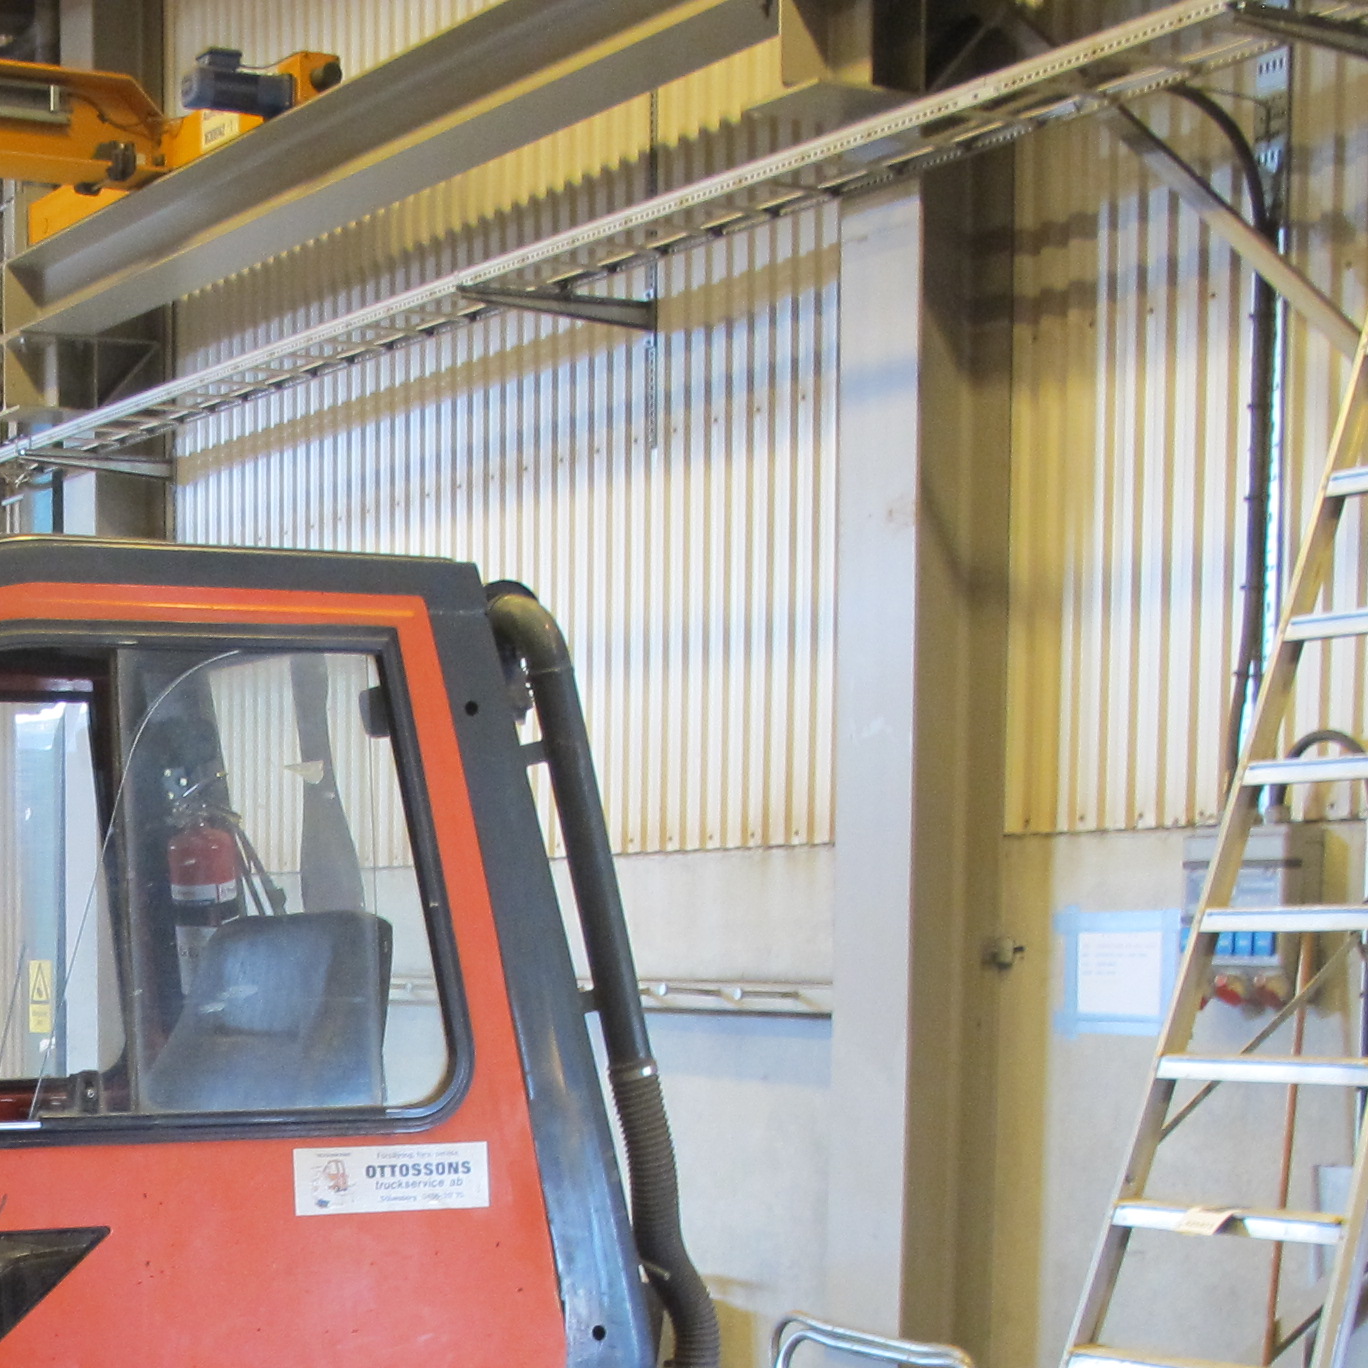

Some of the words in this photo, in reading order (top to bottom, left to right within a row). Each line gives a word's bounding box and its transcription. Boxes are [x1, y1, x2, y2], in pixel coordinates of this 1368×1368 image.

[365, 1161, 472, 1179] OTTOSSONS
[375, 1178, 445, 1191] truckservice
[449, 1176, 464, 1187] ab
